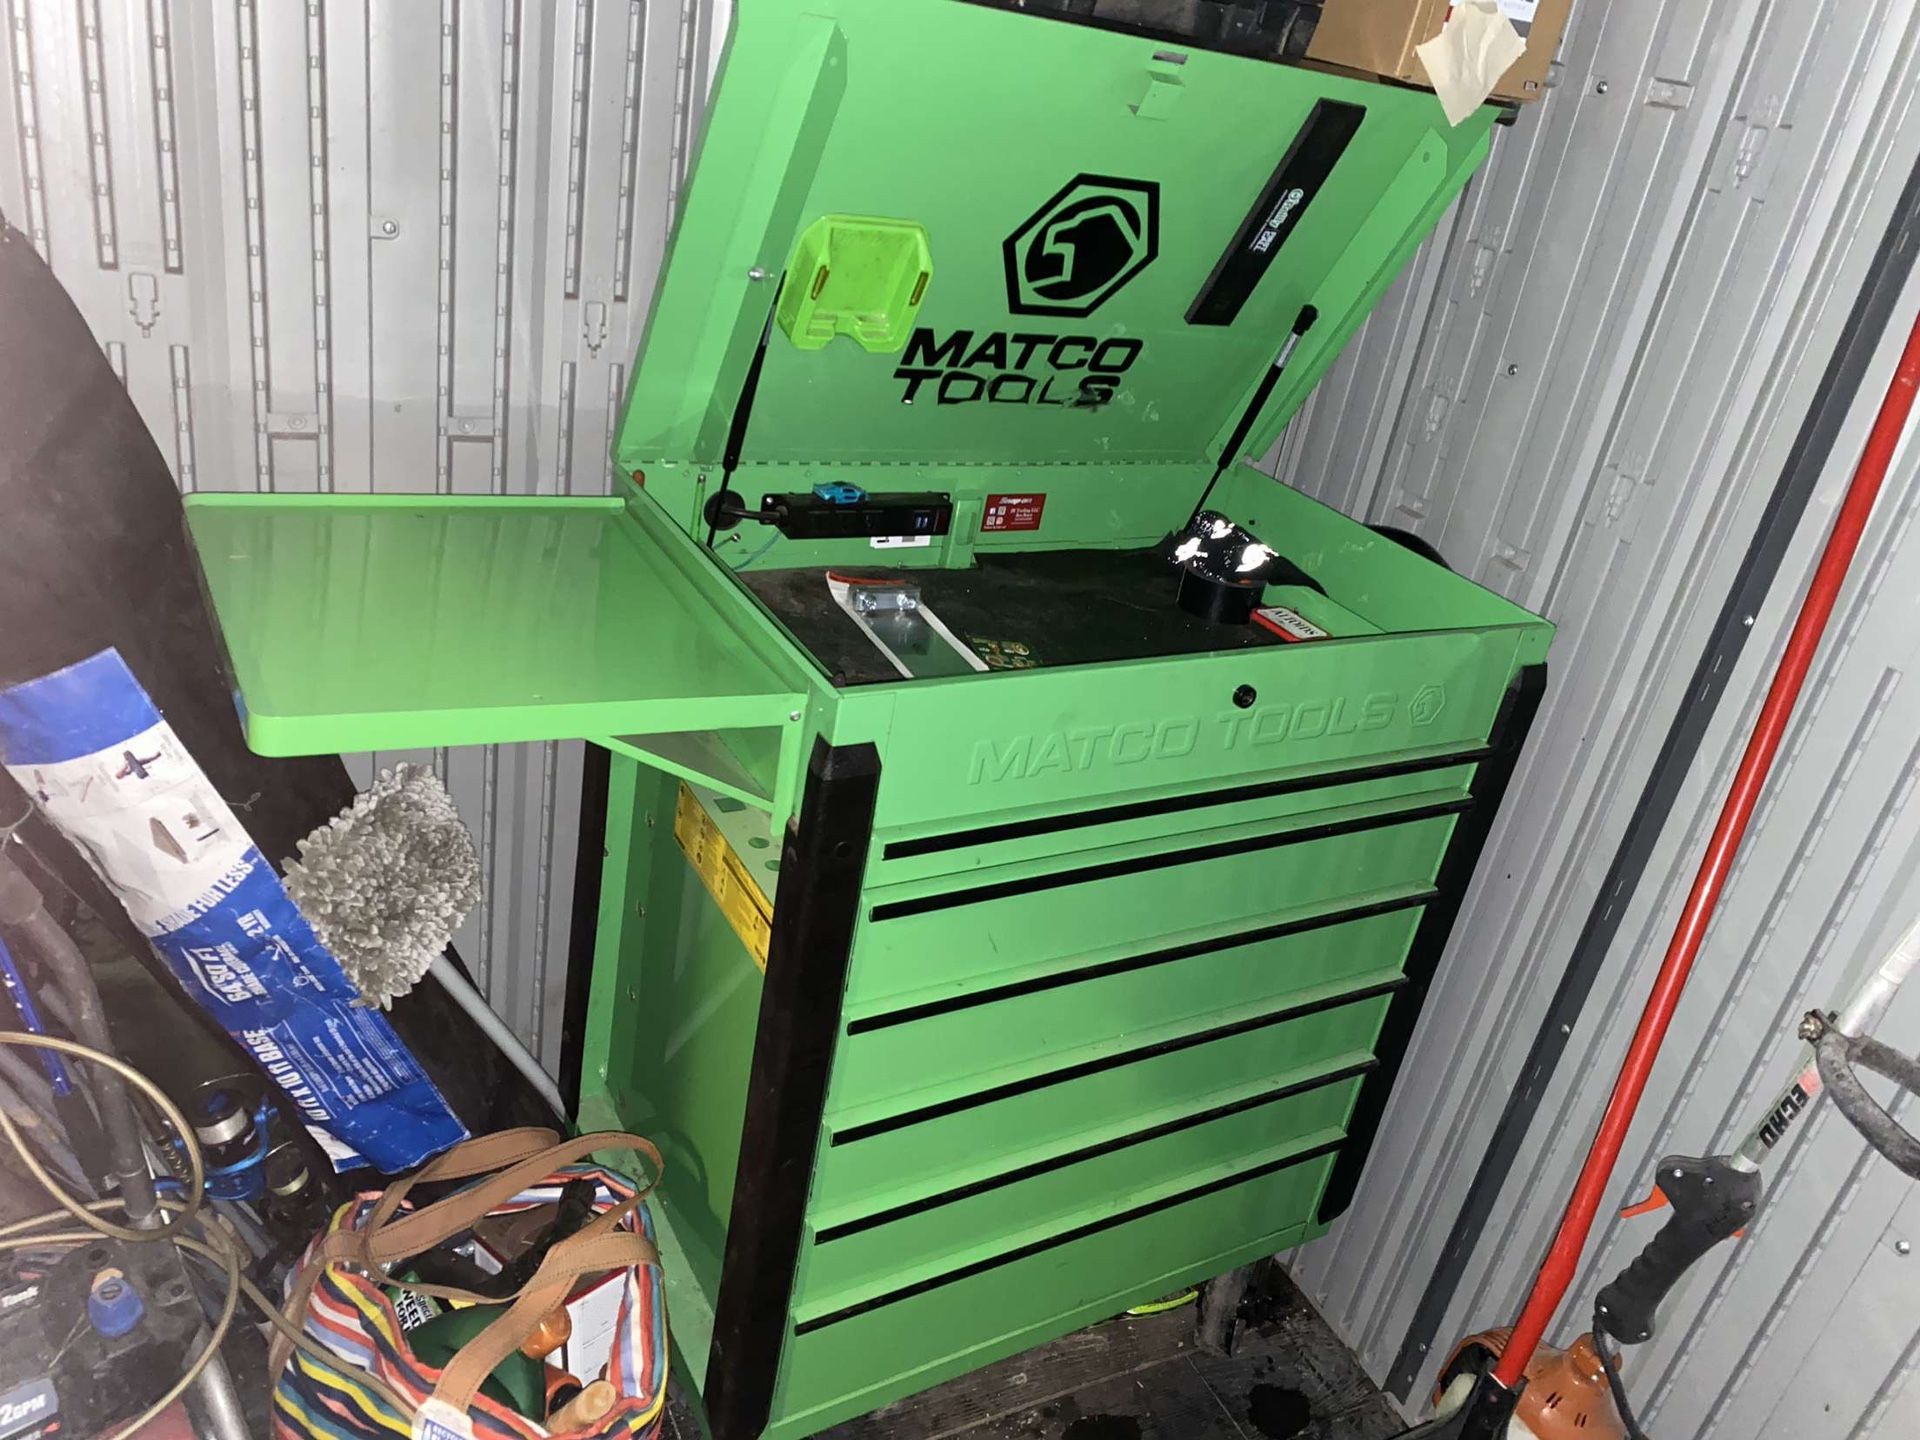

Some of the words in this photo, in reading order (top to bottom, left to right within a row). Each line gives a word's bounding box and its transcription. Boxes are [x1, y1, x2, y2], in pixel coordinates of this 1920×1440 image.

[900, 328, 1144, 373] MATCO
[893, 367, 1121, 408] TOOLS
[966, 717, 1200, 786] MATCO
[1218, 692, 1399, 750] TOOLS
[217, 858, 255, 893] LESS
[242, 1029, 284, 1063] BASE
[1759, 1083, 1809, 1150] ECHO
